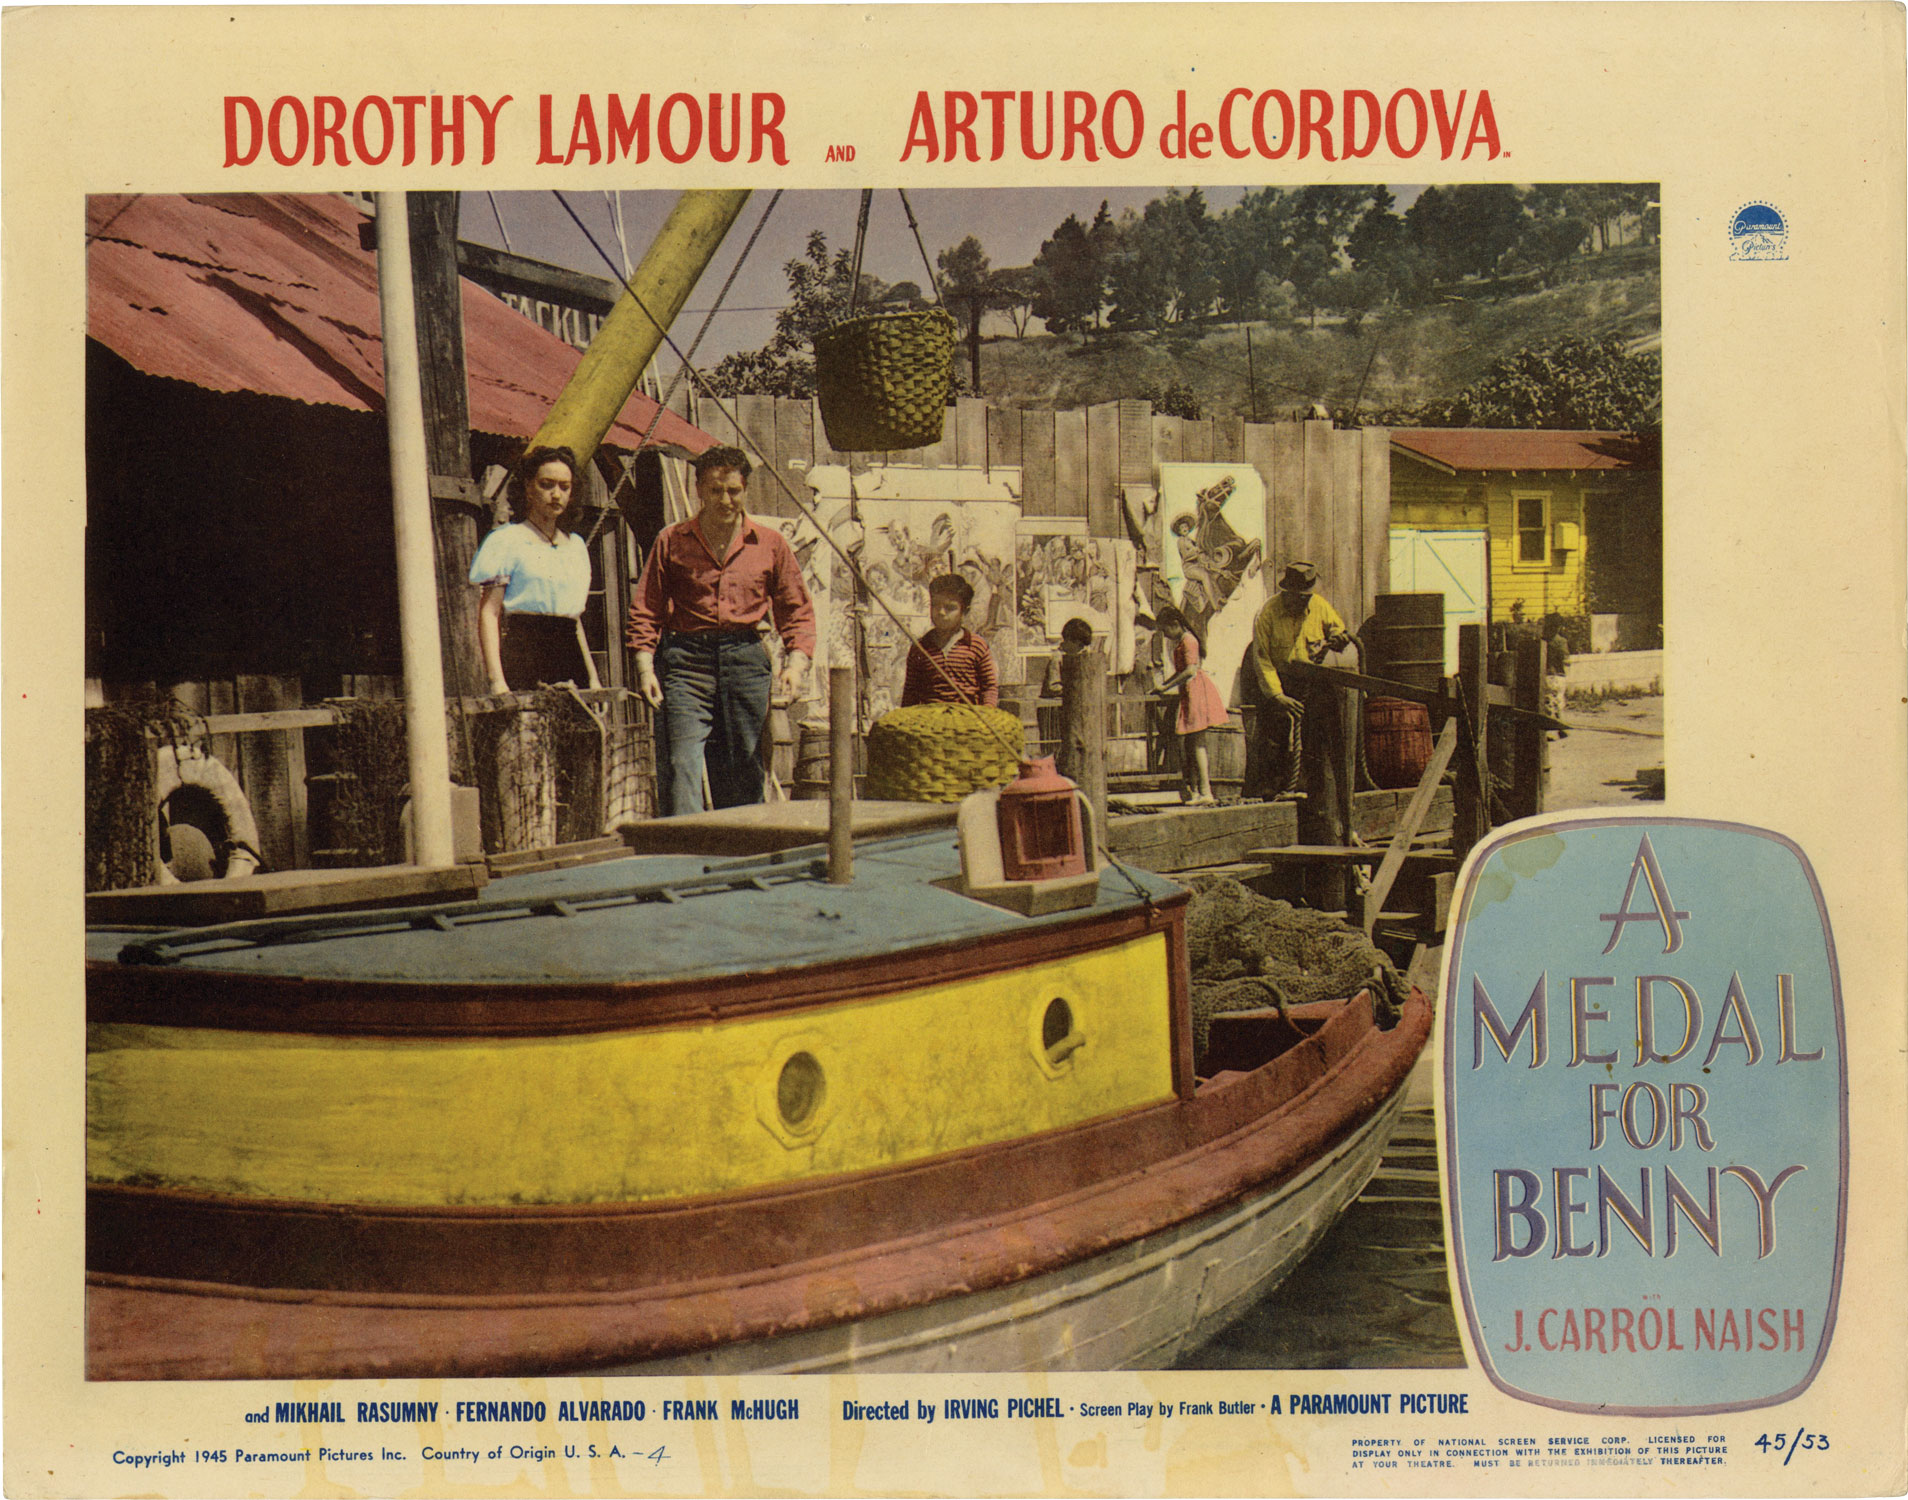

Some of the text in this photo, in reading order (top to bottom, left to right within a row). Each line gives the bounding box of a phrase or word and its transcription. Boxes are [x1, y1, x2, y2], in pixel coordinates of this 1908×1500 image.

[222, 94, 514, 169] DOROTHY
[535, 92, 791, 167] LAMOUR
[824, 144, 857, 164] AND
[899, 89, 1145, 164] ARTURO
[1599, 831, 1691, 955] A
[1472, 970, 1825, 1070] MEDAL
[1589, 1080, 1718, 1152] FOR
[1491, 1163, 1808, 1262] BENNY
[1504, 1307, 1805, 1355] J. CARROL NAISH
[244, 1398, 800, 1424] and MIKHAIL RASUMNY FERNANDO ALVARADO FRANK McHUGH
[842, 1392, 1469, 1425] Directed by IRVING PICHEL Screen Play by Frank Butler A PARAMOUNT PICTURE
[112, 1444, 626, 1470] Copyright 1945 Paramount Pictures Inc. Country of Origin U. S. A.
[1351, 1435, 1726, 1447] PROPERTY OF NATIONAL SCREEN SERVICE CORP. LICENSED FOR
[1351, 1445, 1728, 1458] DISPLAY ONLY IN CONNECTION WITH THE EXHIBITION OF THIS PICTURE
[1754, 1426, 1831, 1467] 45/53
[1351, 1460, 1364, 1469] AT
[1373, 1460, 1398, 1468] YOUR
[1407, 1459, 1455, 1468] THEATRE.
[1473, 1459, 1500, 1468] MUST
[1508, 1459, 1521, 1467] BE
[1660, 1455, 1727, 1465] THEREAFTER.
